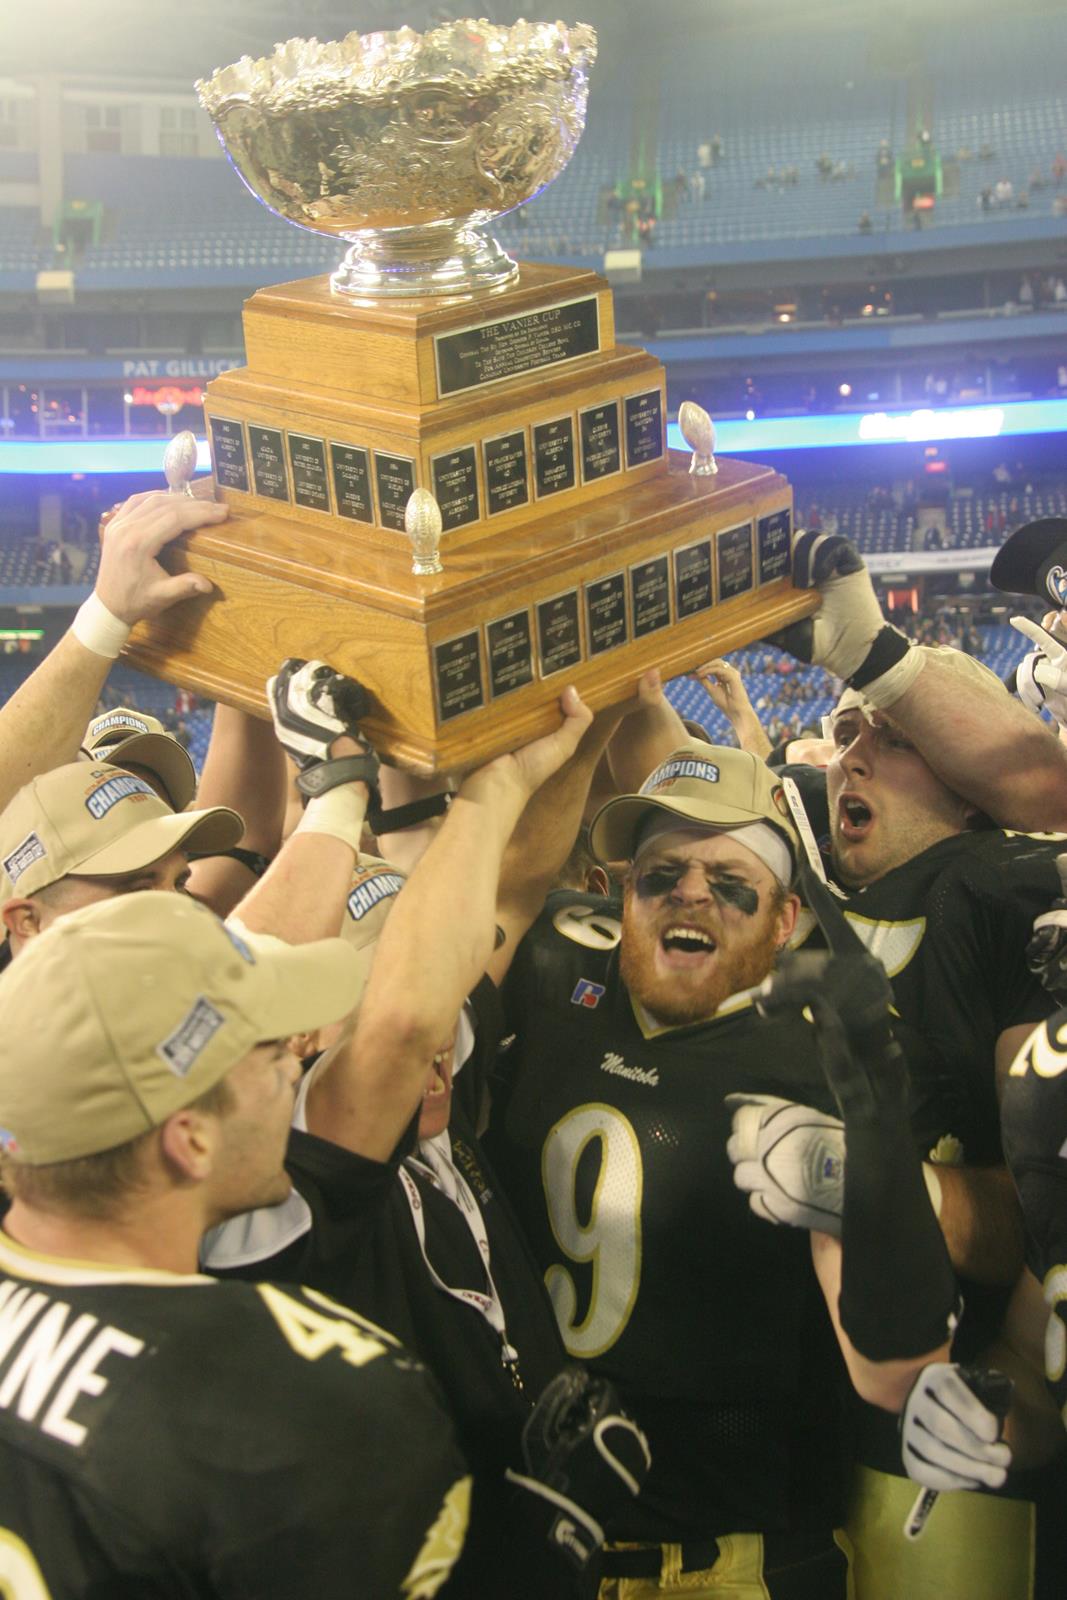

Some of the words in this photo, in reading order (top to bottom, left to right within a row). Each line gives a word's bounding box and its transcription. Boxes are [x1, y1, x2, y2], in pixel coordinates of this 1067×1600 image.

[480, 326, 500, 339] THE
[502, 315, 540, 332] VANIER
[542, 309, 561, 322] CUP
[123, 360, 159, 377] PAT
[92, 715, 149, 736] CHAMPIONS
[601, 1052, 659, 1087] Manitoba
[541, 1102, 643, 1358] 9
